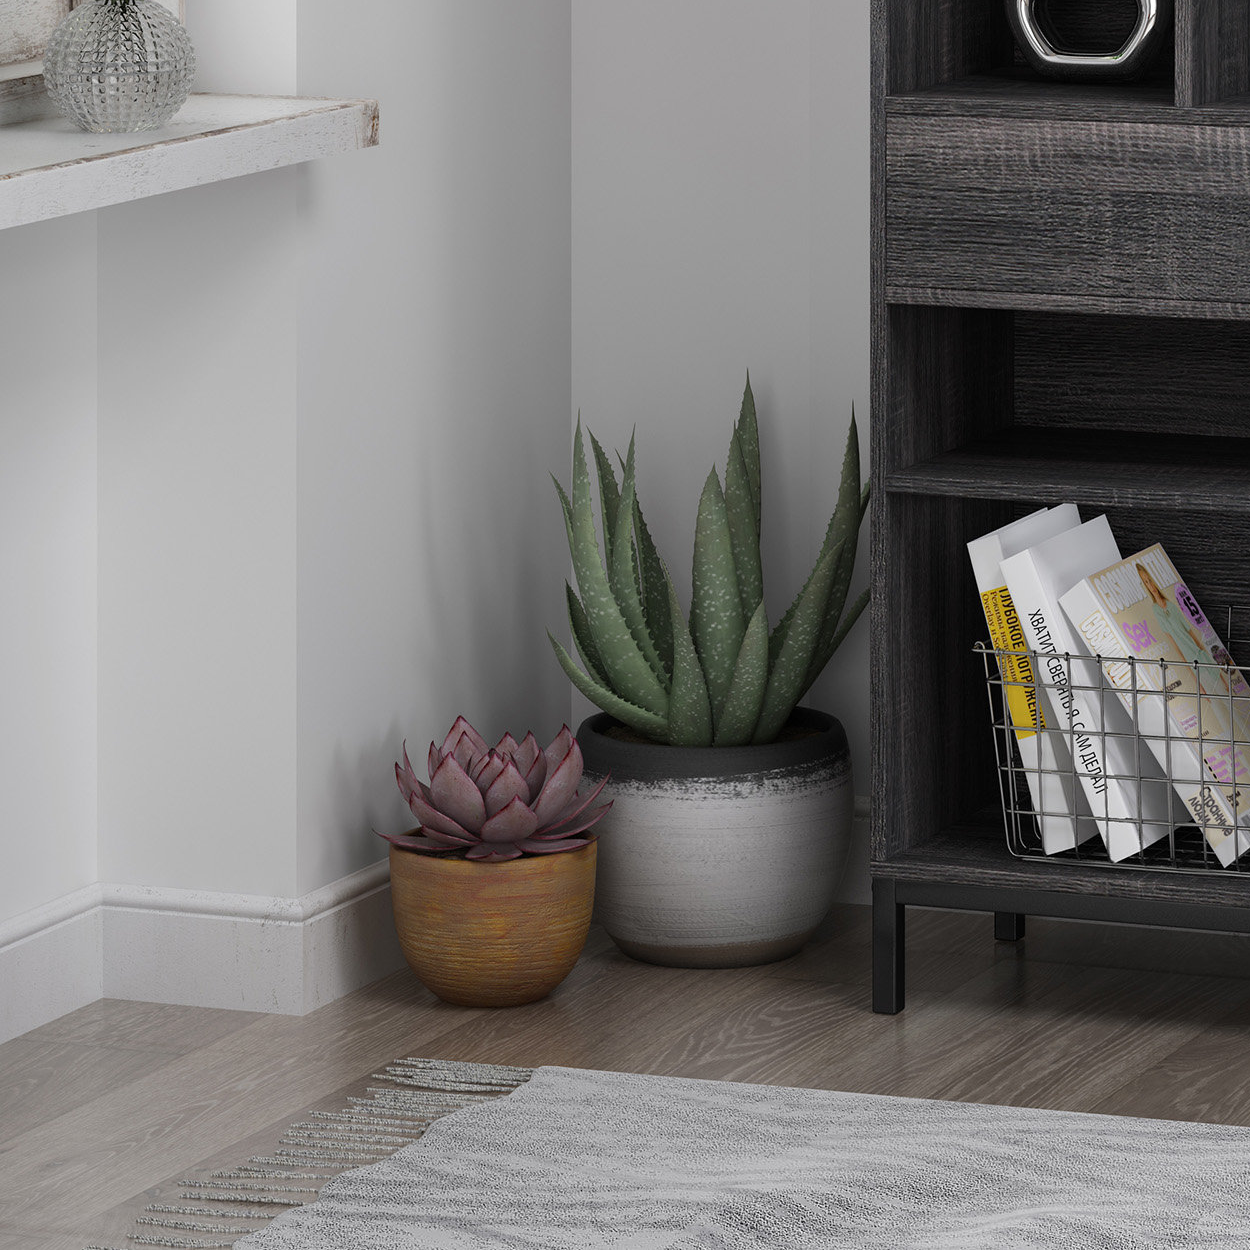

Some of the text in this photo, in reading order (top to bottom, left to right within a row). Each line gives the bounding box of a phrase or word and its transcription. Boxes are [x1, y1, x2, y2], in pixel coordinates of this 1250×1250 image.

[1094, 548, 1179, 614] COSMOPITAN
[982, 593, 995, 626] Overlay
[1183, 596, 1200, 617] 15
[1028, 608, 1057, 655] ХВАТИТ
[1122, 619, 1158, 652] Sex
[1072, 722, 1092, 752] САМ
[1079, 751, 1108, 794] ДЕЛАЛ
